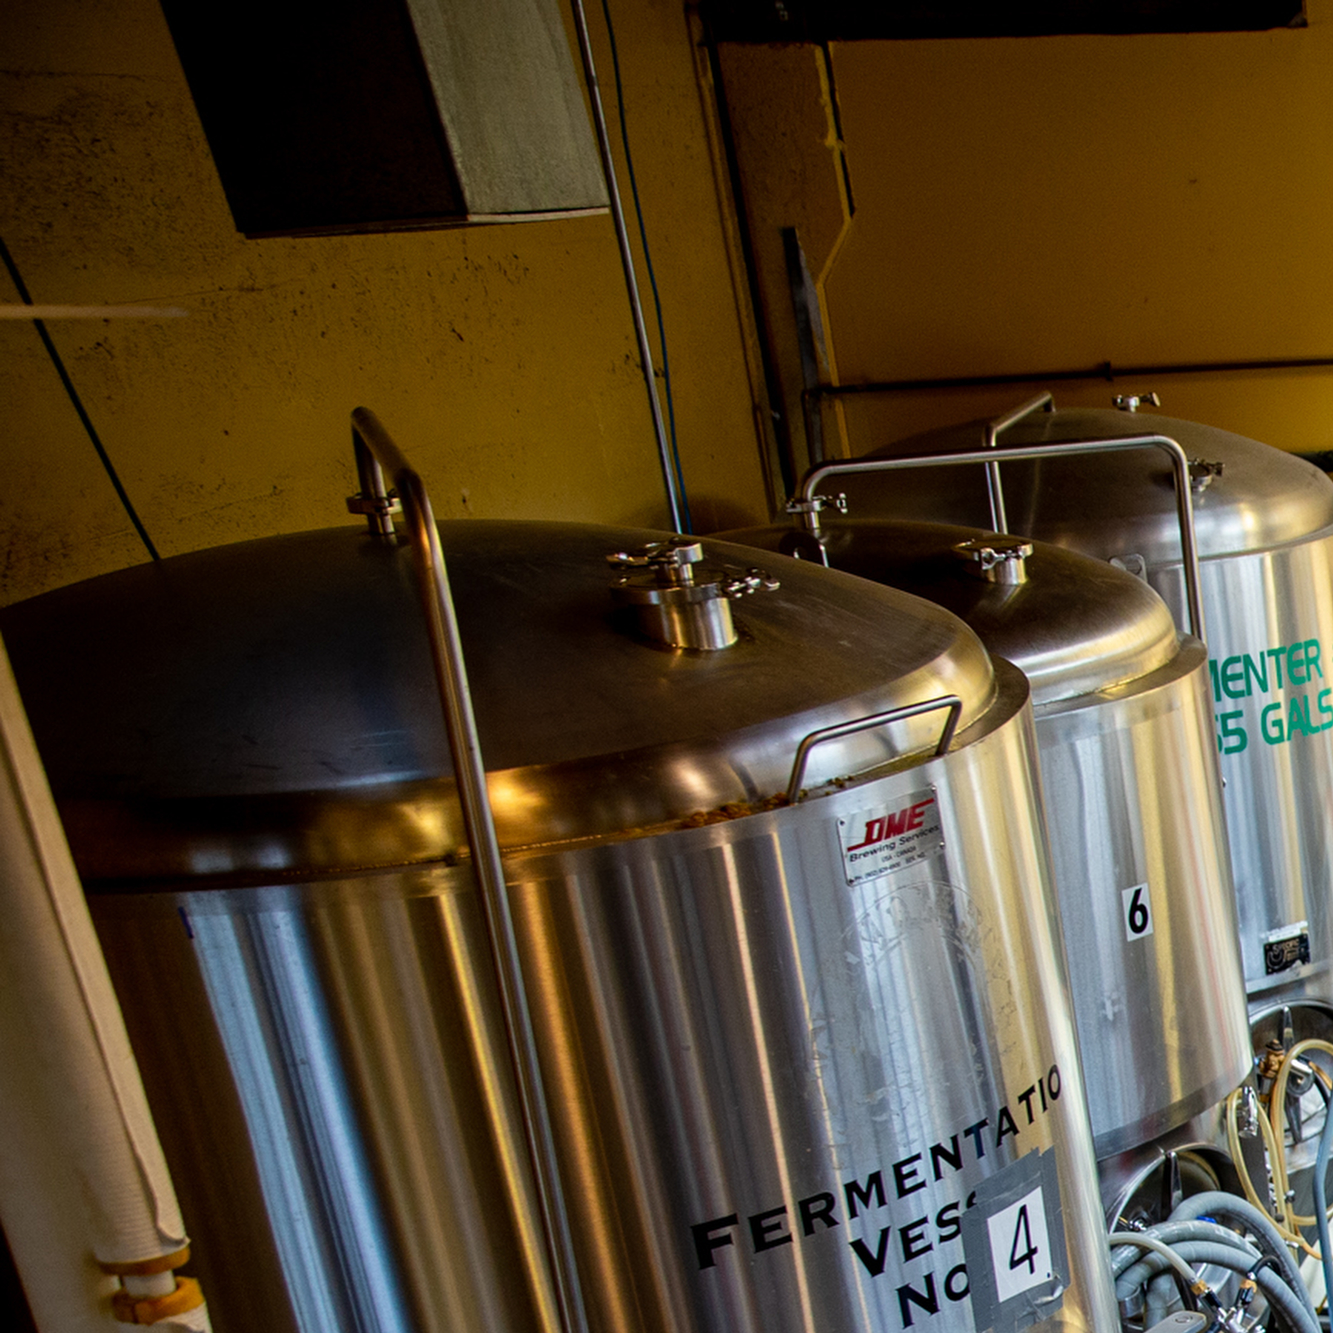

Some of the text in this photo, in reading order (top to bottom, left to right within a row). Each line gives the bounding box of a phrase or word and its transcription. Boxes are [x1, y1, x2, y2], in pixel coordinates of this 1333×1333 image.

[1214, 709, 1248, 755] 5
[849, 825, 940, 862] Brewing Services
[1128, 887, 1149, 935] 6
[1008, 1204, 1039, 1275] 4
